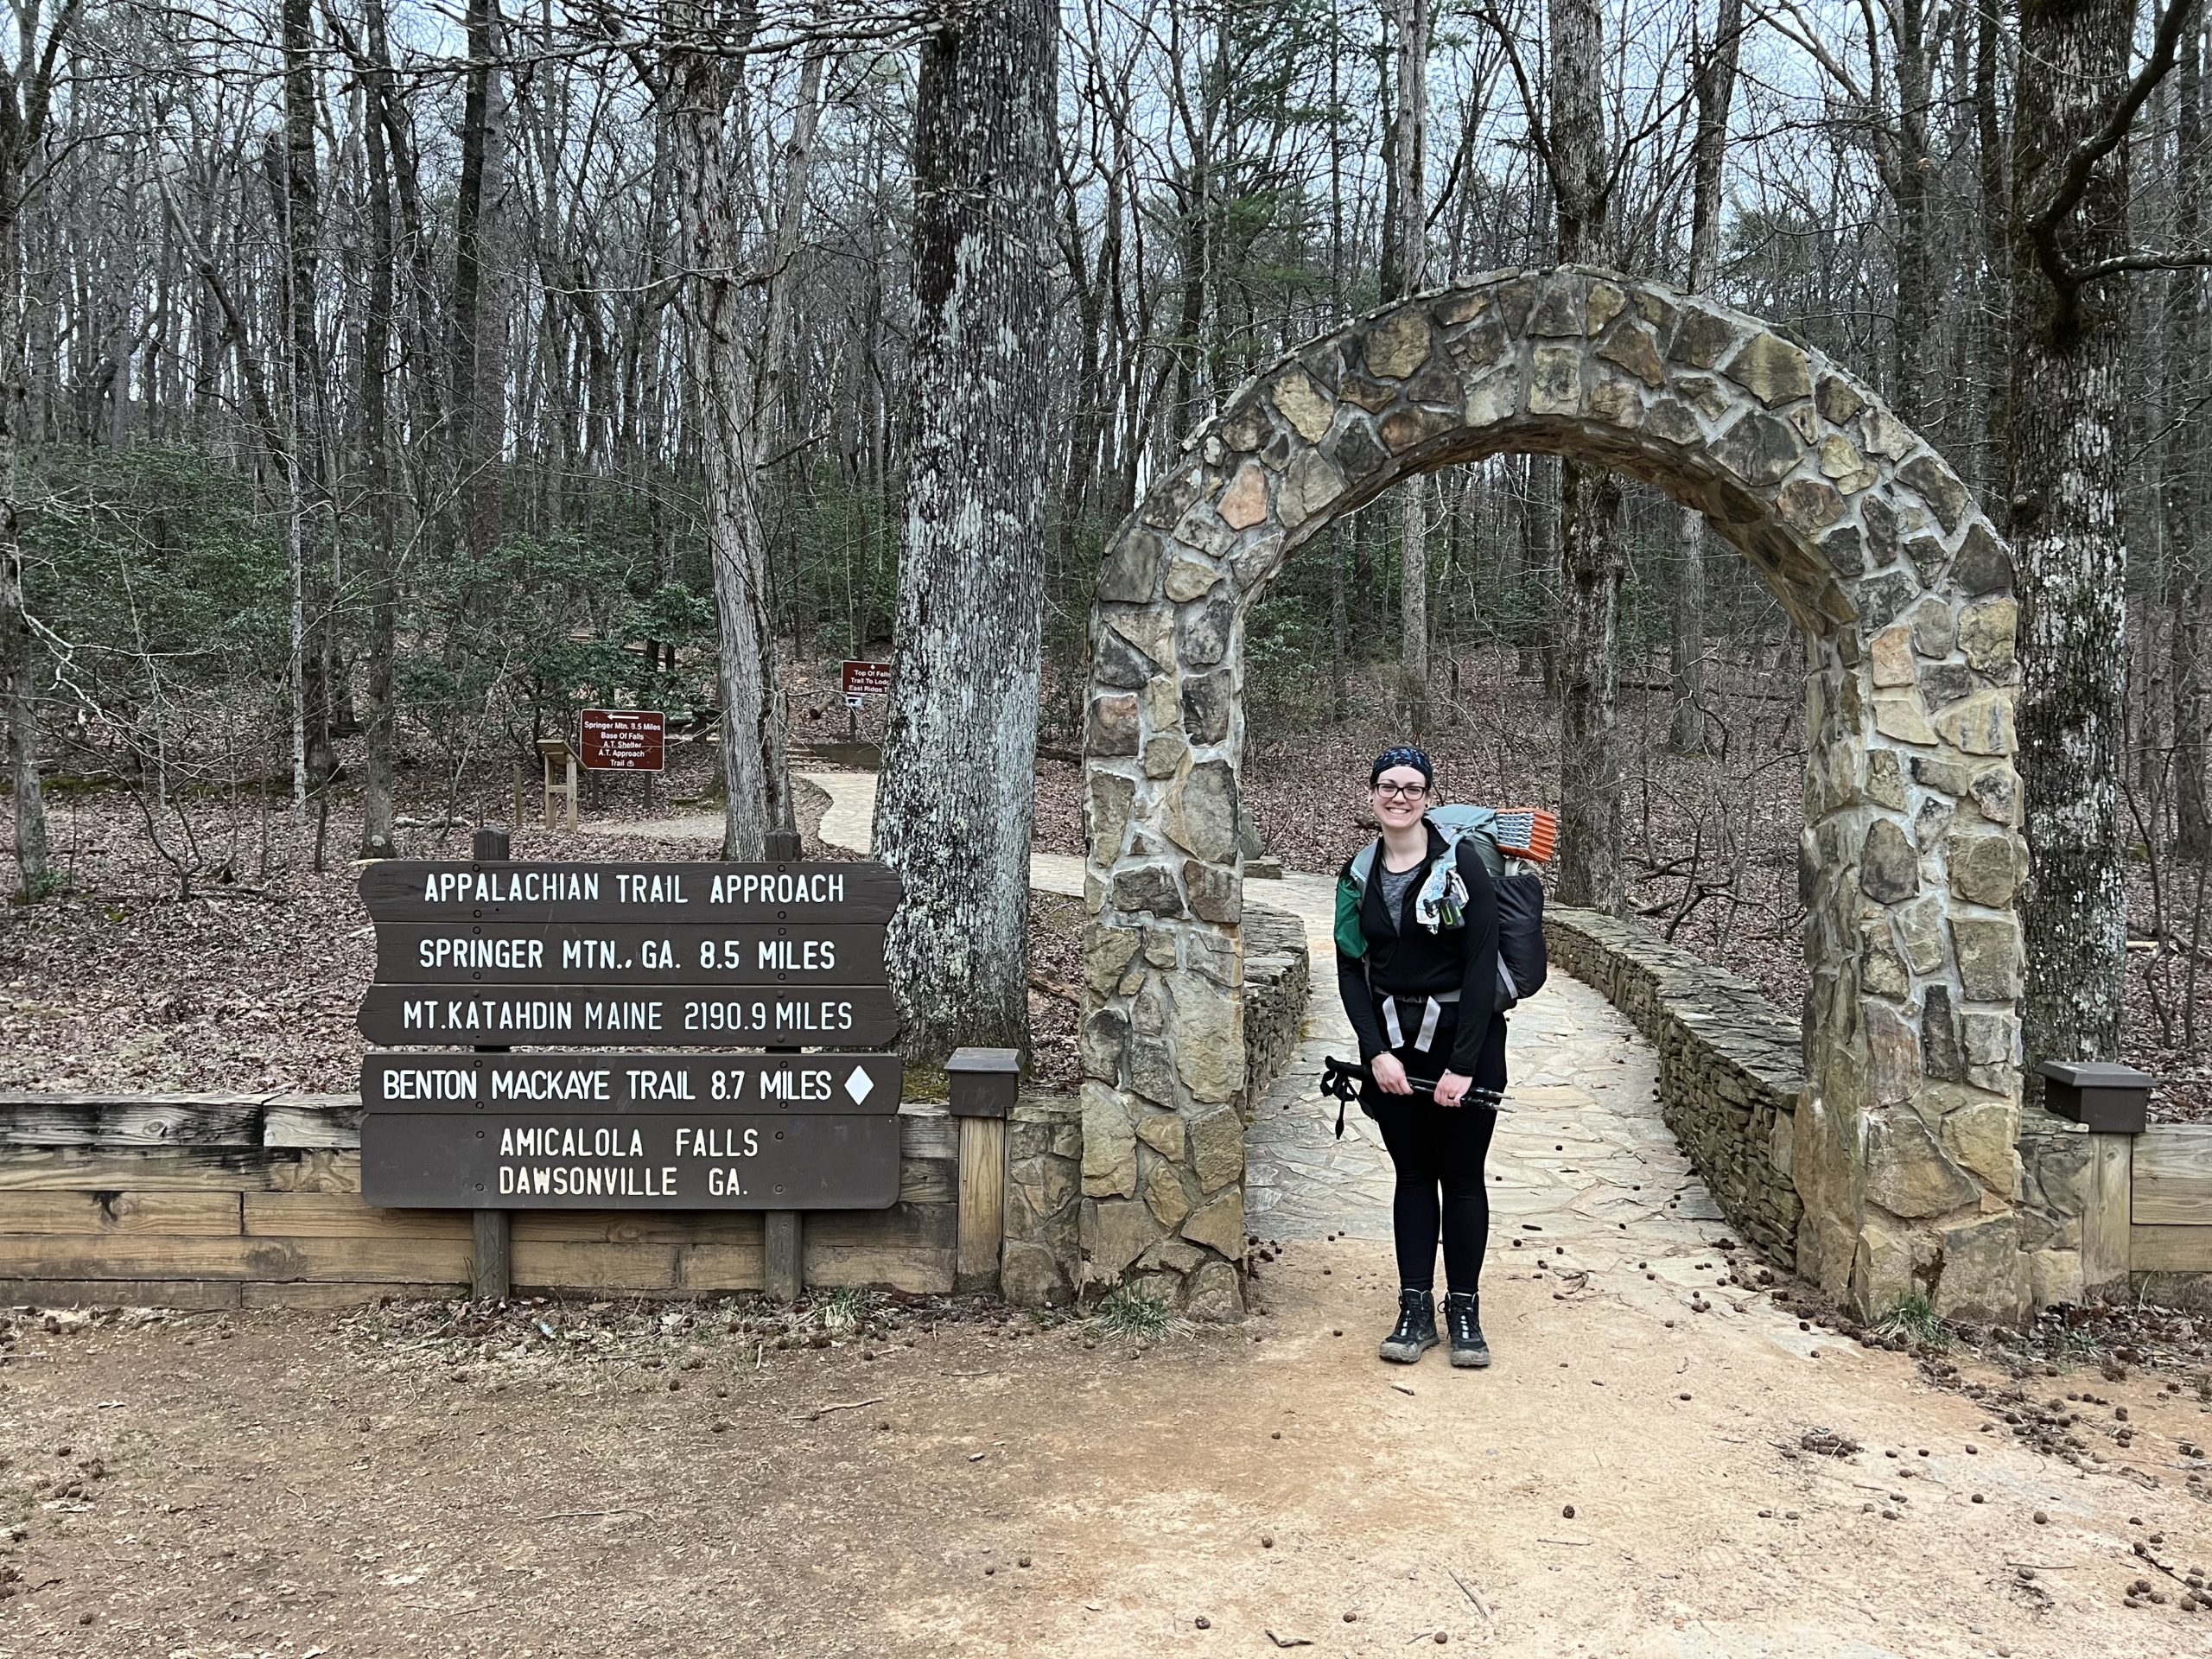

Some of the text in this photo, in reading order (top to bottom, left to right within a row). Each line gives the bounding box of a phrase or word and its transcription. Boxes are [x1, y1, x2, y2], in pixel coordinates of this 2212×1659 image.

[612, 749, 645, 758] Approach
[424, 873, 843, 904] APPALACHIAN TRAIL APPROACH
[419, 938, 835, 970] SPRINGER MTN., GA. 8.5 MILES
[585, 1001, 663, 1030] MAINE
[684, 1001, 766, 1030] 2190.9
[776, 1001, 852, 1030] MILES
[383, 1070, 832, 1101] BENTON MACKAYE TRAIL 8.7 MILES
[499, 1127, 759, 1157] AMICALOLA FALLS
[499, 1166, 748, 1196] DAWSONVILLE GA.
